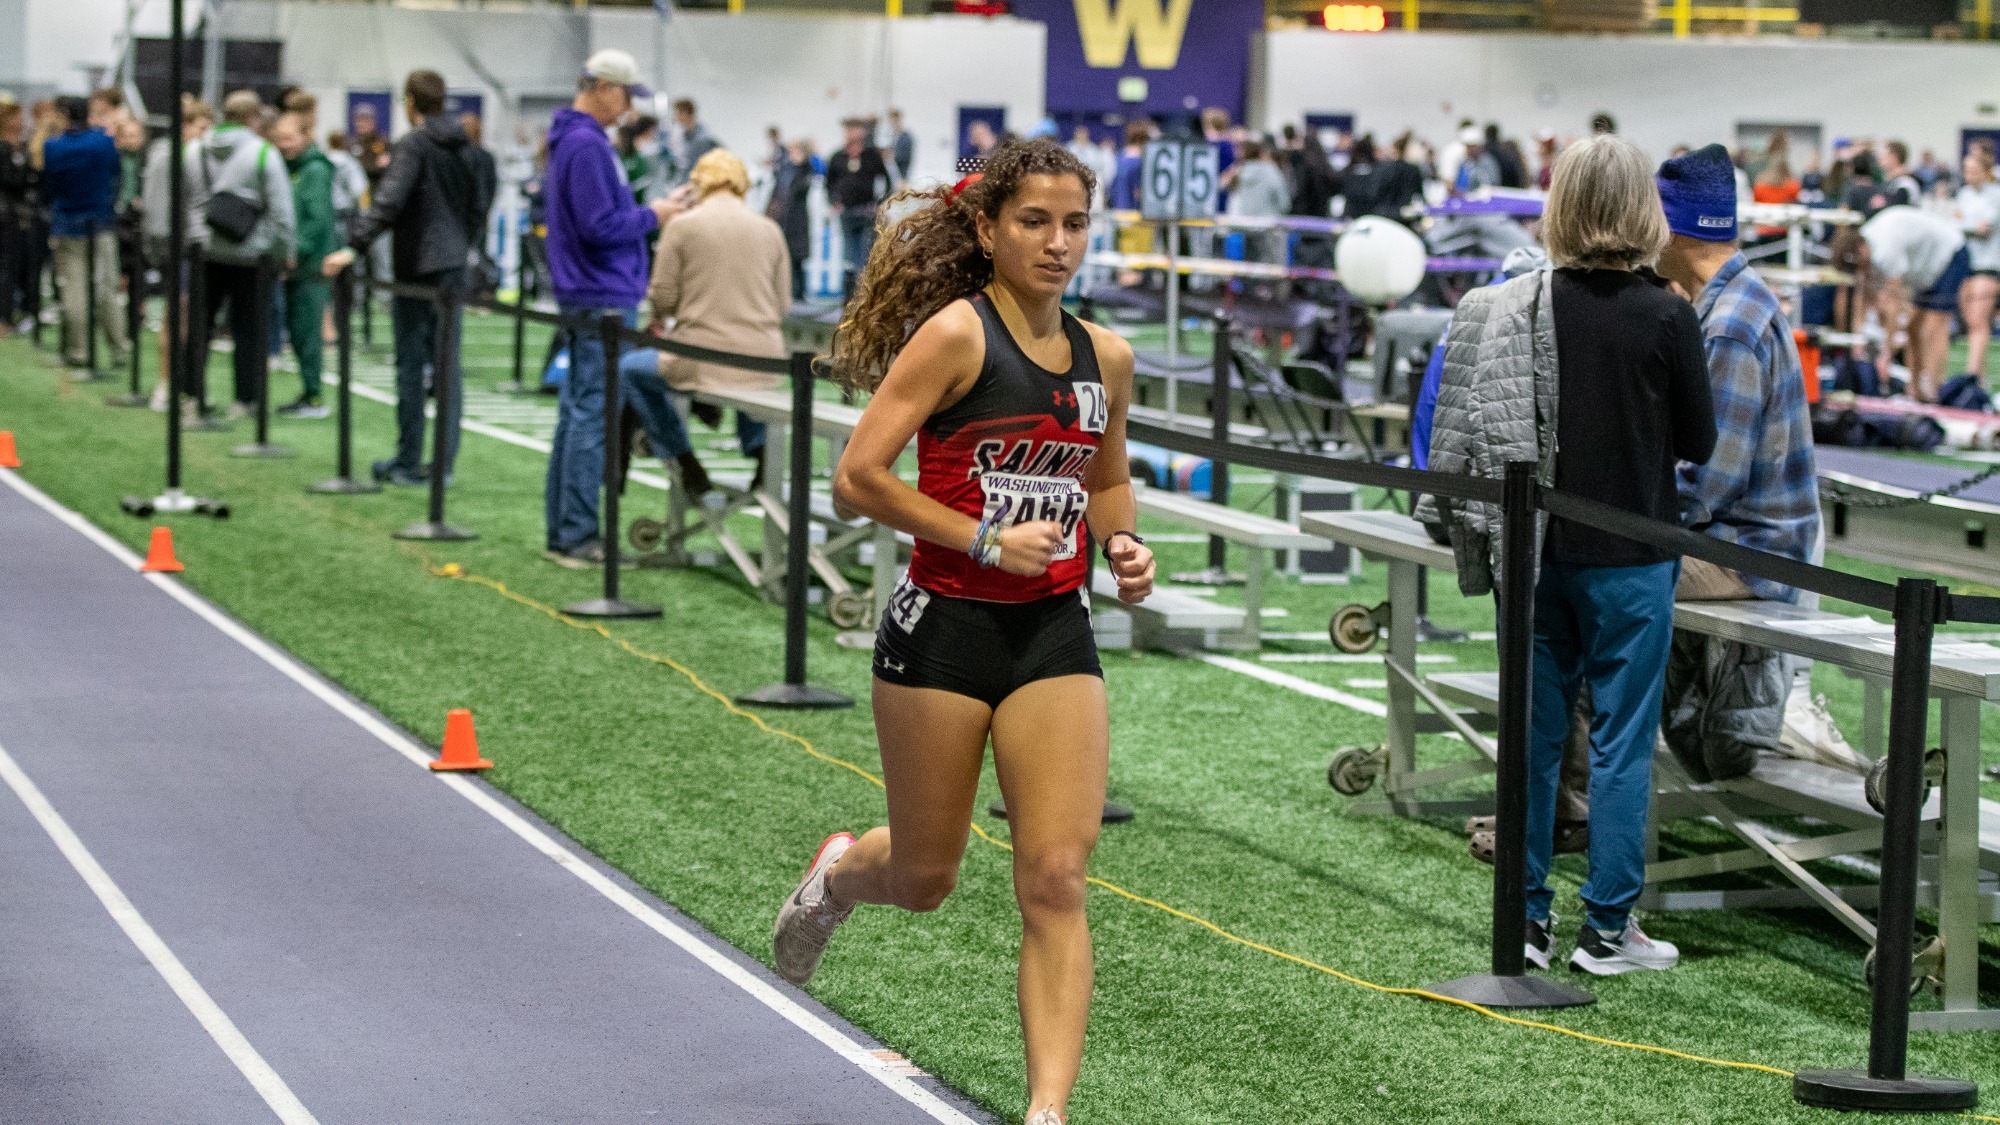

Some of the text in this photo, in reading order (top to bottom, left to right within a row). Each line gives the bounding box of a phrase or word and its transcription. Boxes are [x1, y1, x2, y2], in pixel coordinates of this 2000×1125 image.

[1072, 0, 1194, 69] W
[1152, 148, 1211, 201] 65
[1081, 384, 1105, 431] 24
[987, 476, 1075, 495] WASHINGTON
